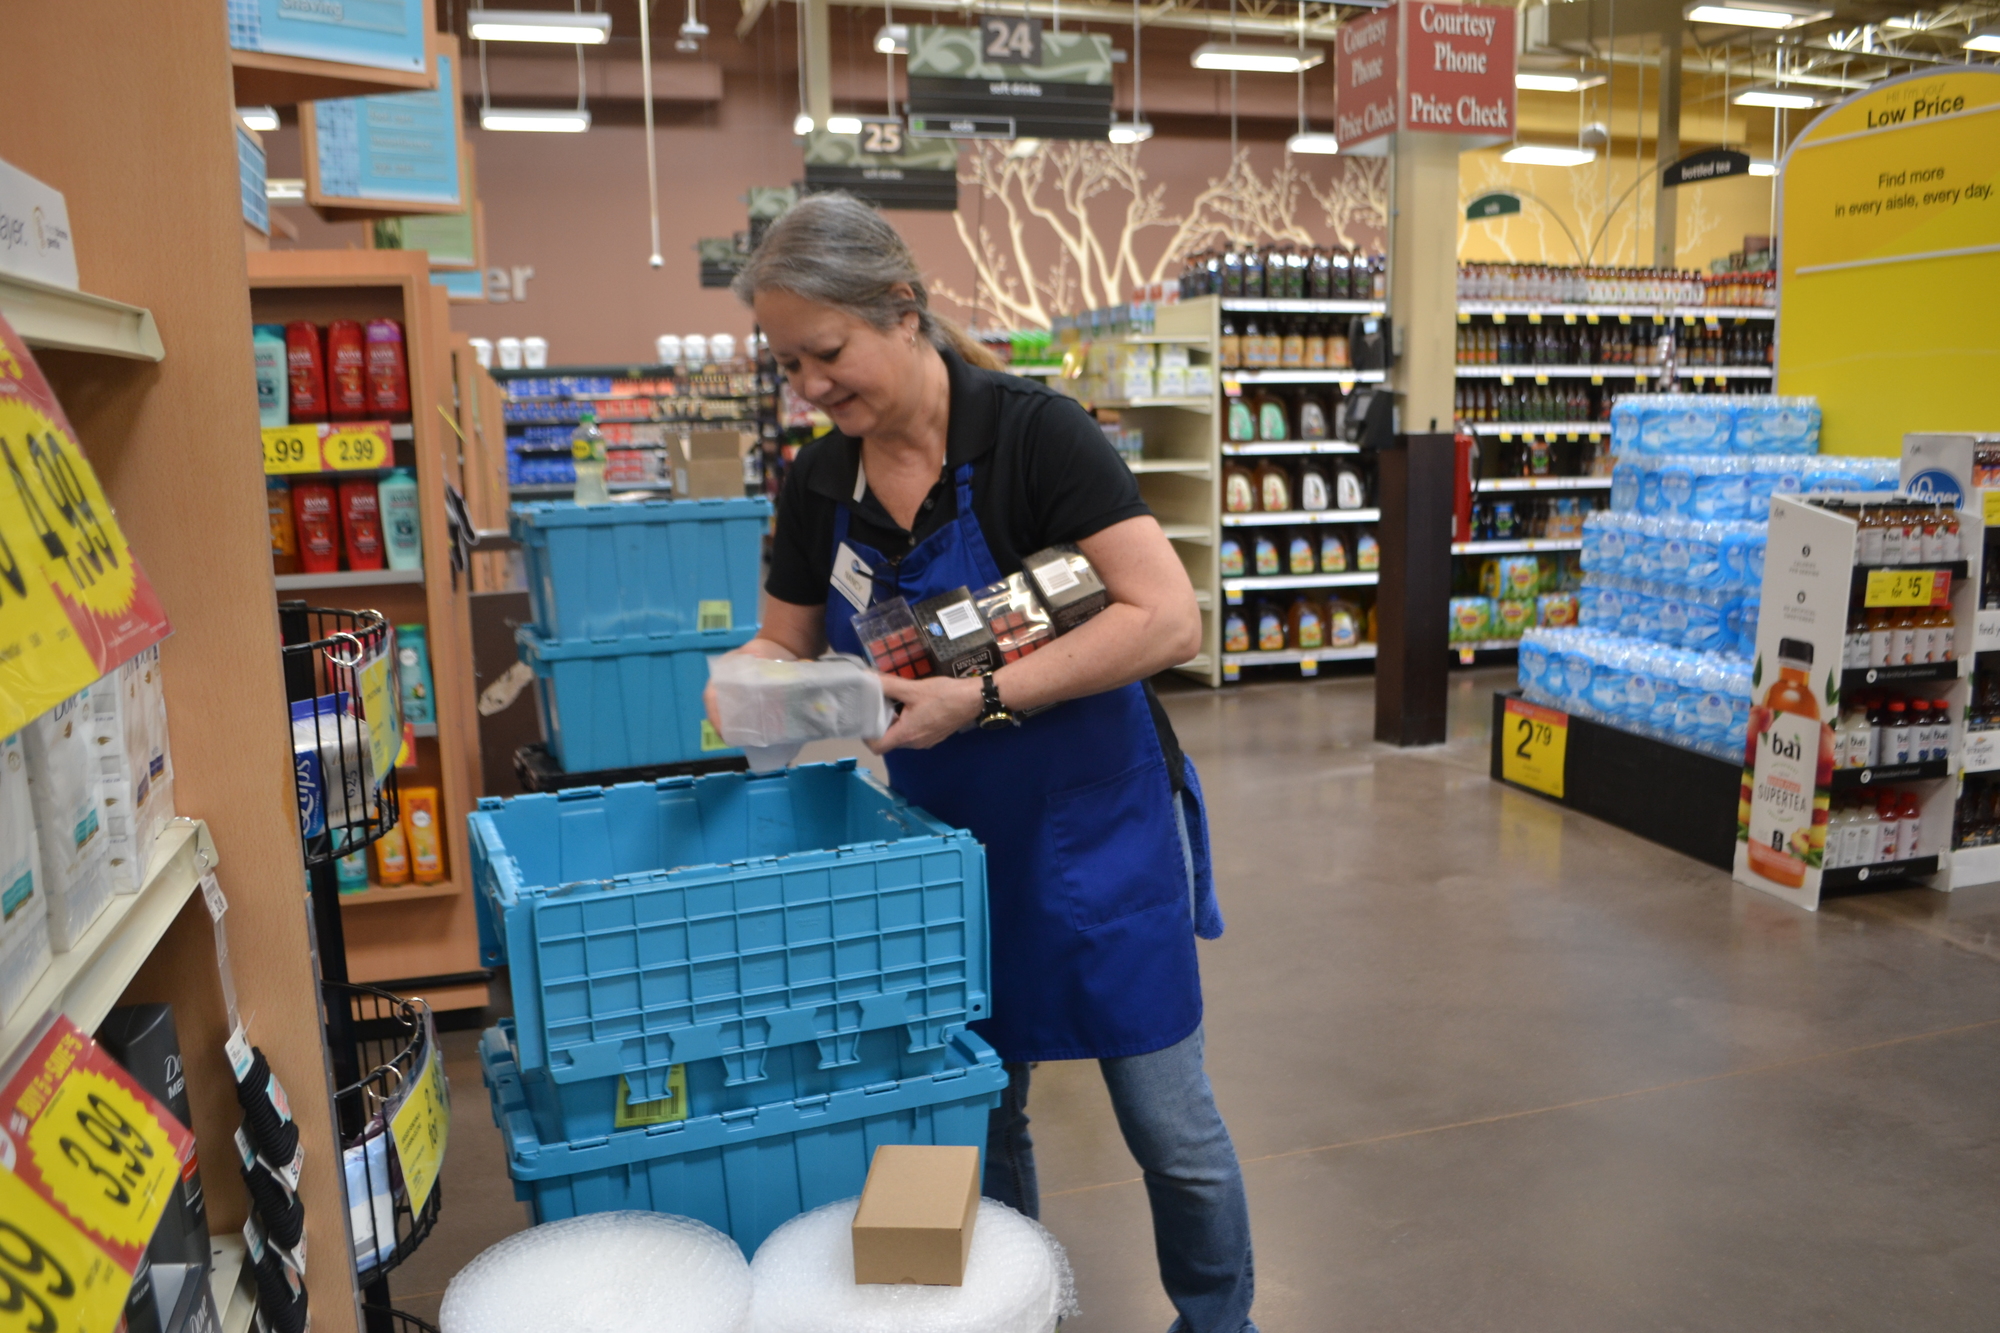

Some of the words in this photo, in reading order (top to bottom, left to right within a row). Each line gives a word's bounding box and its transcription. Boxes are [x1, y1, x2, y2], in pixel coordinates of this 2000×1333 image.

[986, 20, 1034, 59] 24
[1343, 16, 1389, 55] Courtesy
[1420, 4, 1495, 45] Courtesy
[1351, 54, 1384, 88] Phone
[1434, 40, 1487, 74] Phone
[1338, 113, 1363, 142] Price
[1363, 97, 1396, 133] Check
[1410, 92, 1453, 124] Price
[1456, 95, 1508, 128] Check
[1867, 107, 1906, 129] Low
[1913, 94, 1965, 120] Price
[864, 123, 902, 153] 25
[1681, 162, 1715, 180] bottled
[1716, 160, 1731, 174] tea
[1878, 170, 1906, 188] Find
[1909, 167, 1945, 183] more
[1834, 203, 1845, 218] in
[1848, 199, 1882, 216] every
[1885, 192, 1919, 210] aisle,
[1922, 187, 1961, 206] every
[1964, 182, 1993, 200] day.
[338, 438, 374, 462] 2.99
[1772, 732, 1801, 761] bai
[1758, 784, 1807, 813] SUPERTEA
[164, 1055, 182, 1084] Do
[59, 1093, 154, 1207] 3.99
